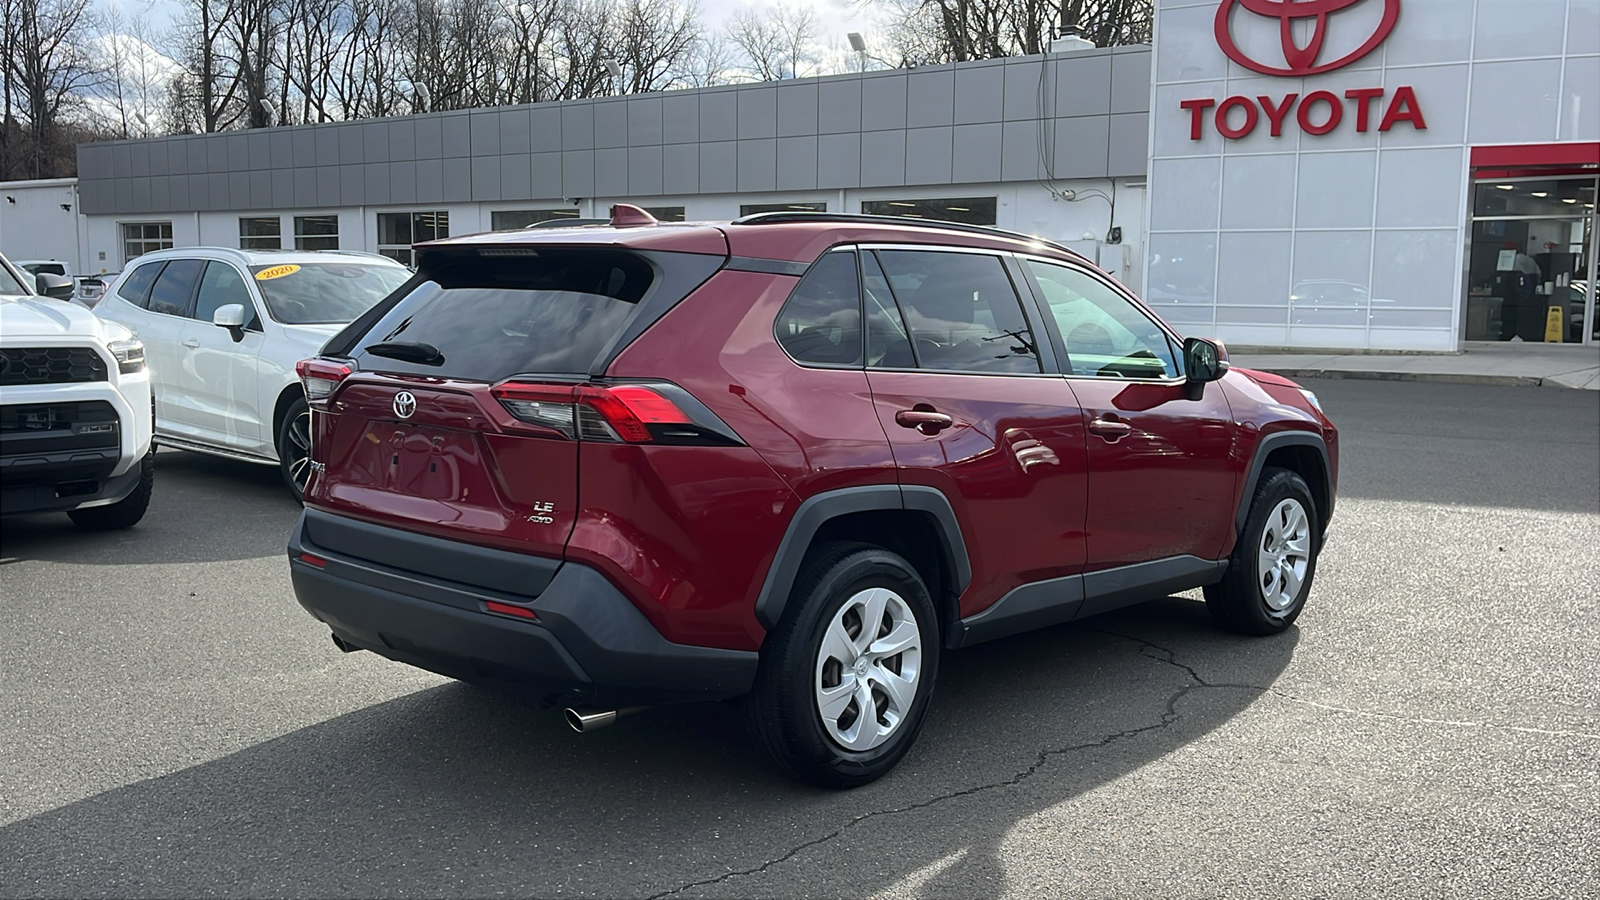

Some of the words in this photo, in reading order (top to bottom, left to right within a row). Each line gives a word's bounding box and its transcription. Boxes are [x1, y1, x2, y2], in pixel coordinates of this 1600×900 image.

[1180, 86, 1427, 140] TOYOTA
[263, 265, 294, 278] 2020
[533, 501, 555, 512] LE
[526, 515, 554, 524] AWD
